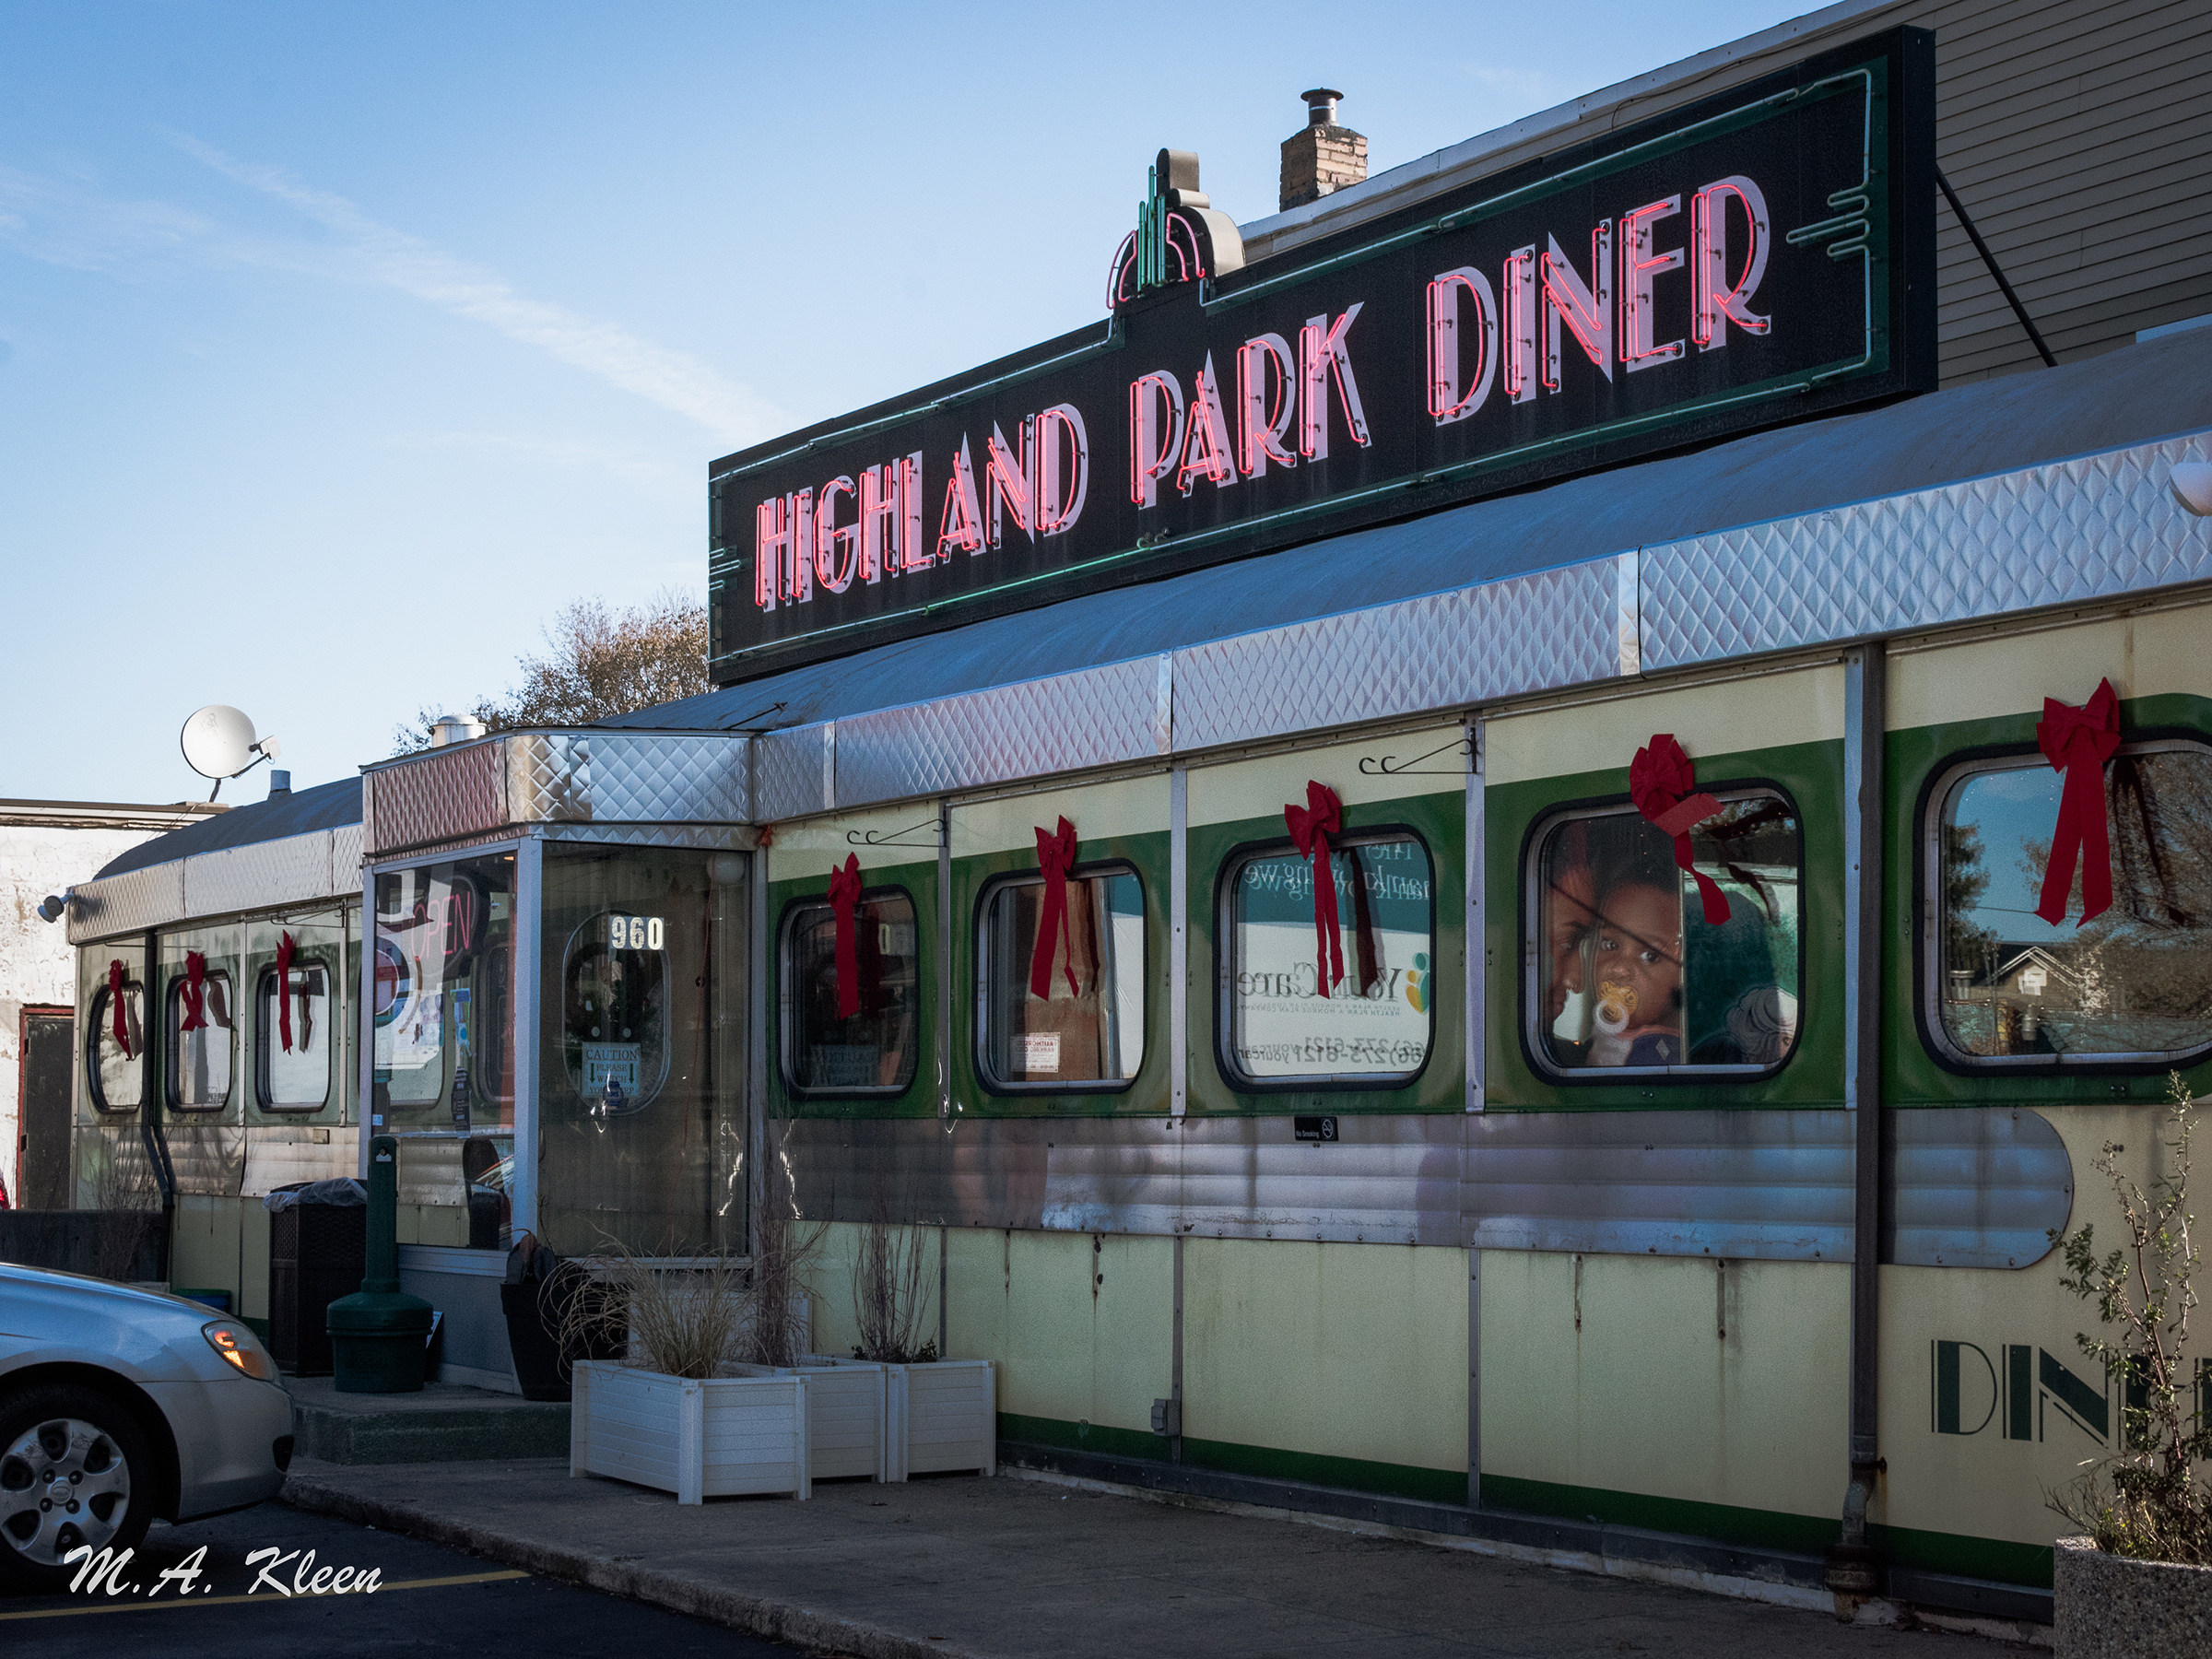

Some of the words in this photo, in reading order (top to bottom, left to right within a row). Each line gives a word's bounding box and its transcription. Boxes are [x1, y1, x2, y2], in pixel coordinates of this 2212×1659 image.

[756, 402, 1088, 613] HIGHLAND
[1129, 301, 1372, 510] PARK
[1427, 174, 1771, 428] DINER
[411, 891, 471, 959] OPEN
[612, 917, 664, 949] 960
[586, 1049, 637, 1061] CAUTION
[596, 1064, 628, 1072] PLEASE
